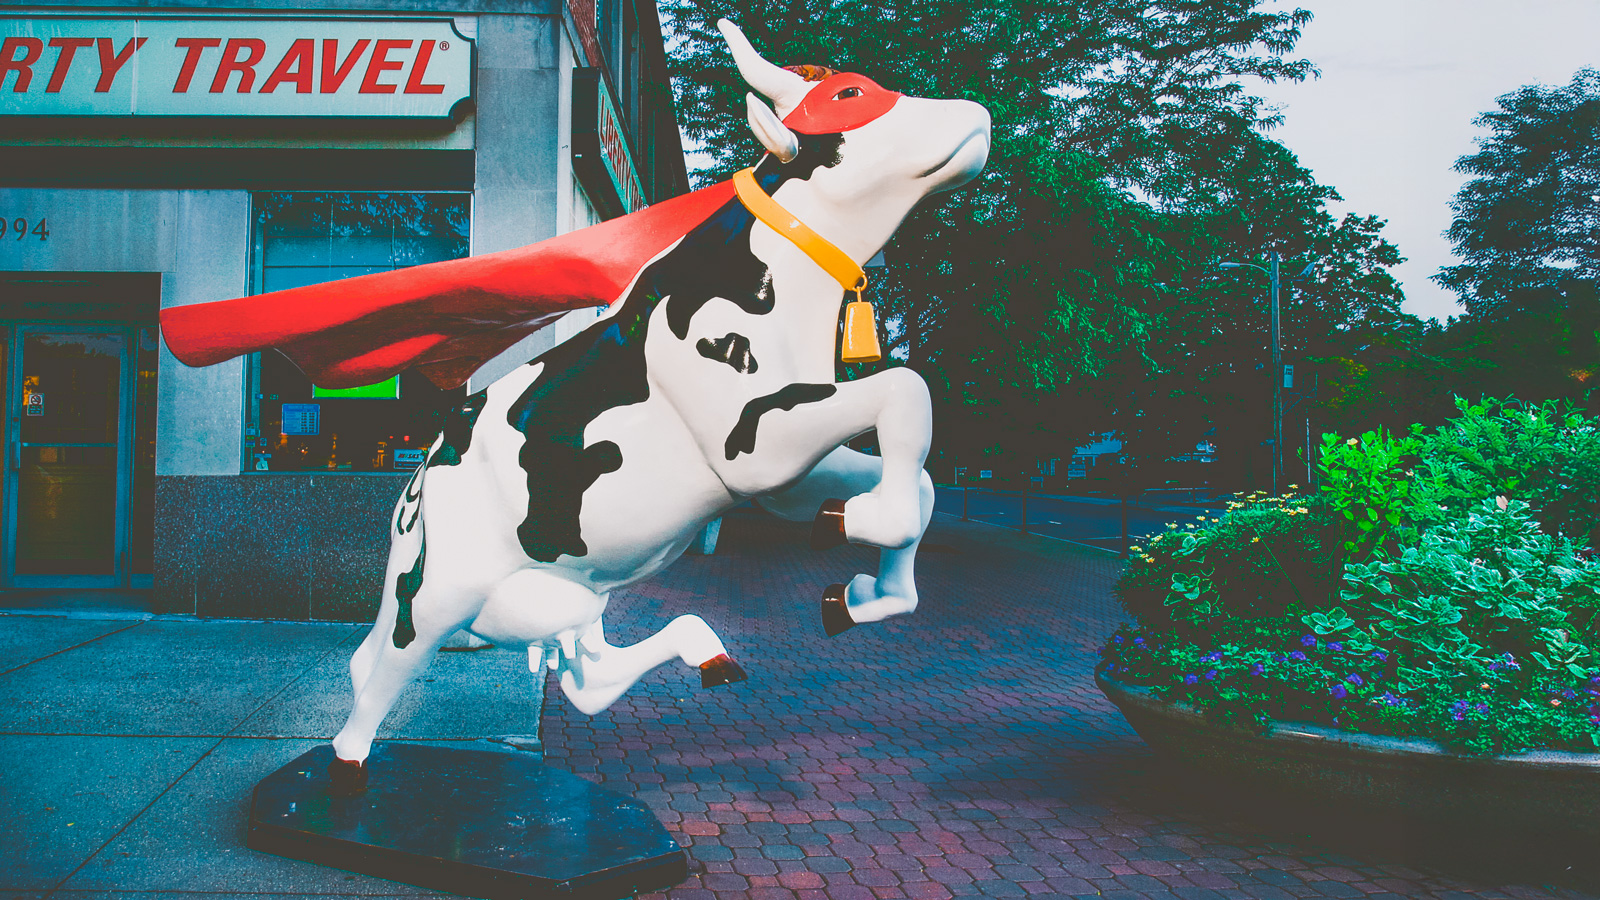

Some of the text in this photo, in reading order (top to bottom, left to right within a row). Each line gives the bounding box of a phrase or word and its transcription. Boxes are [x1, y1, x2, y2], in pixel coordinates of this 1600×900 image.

[0, 37, 446, 94] RTY TRAVEL
[600, 94, 632, 200] LIBERTY
